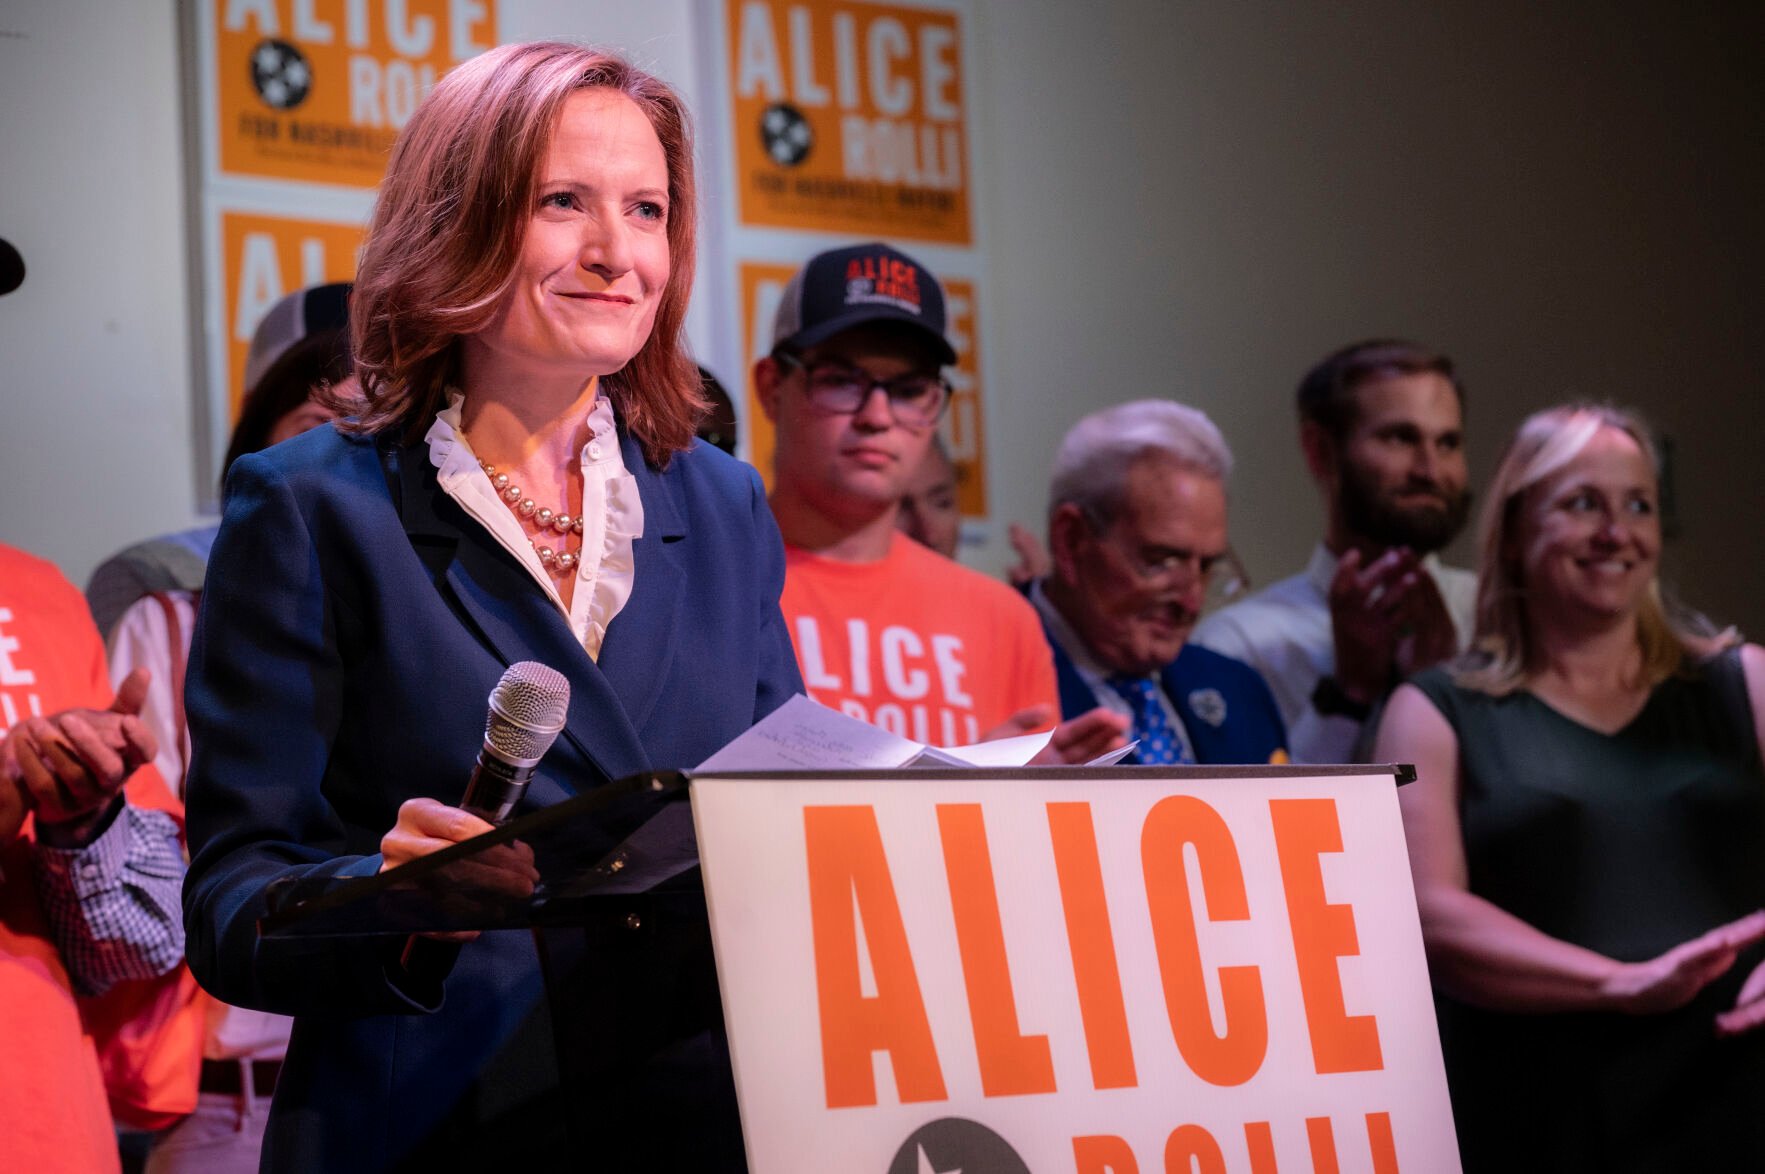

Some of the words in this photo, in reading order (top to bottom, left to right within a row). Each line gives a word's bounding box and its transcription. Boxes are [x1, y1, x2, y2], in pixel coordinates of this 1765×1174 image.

[738, 0, 959, 120] ALICE
[846, 255, 917, 287] ALICE
[795, 616, 973, 708] LICE
[803, 795, 1385, 1109] ALICE
